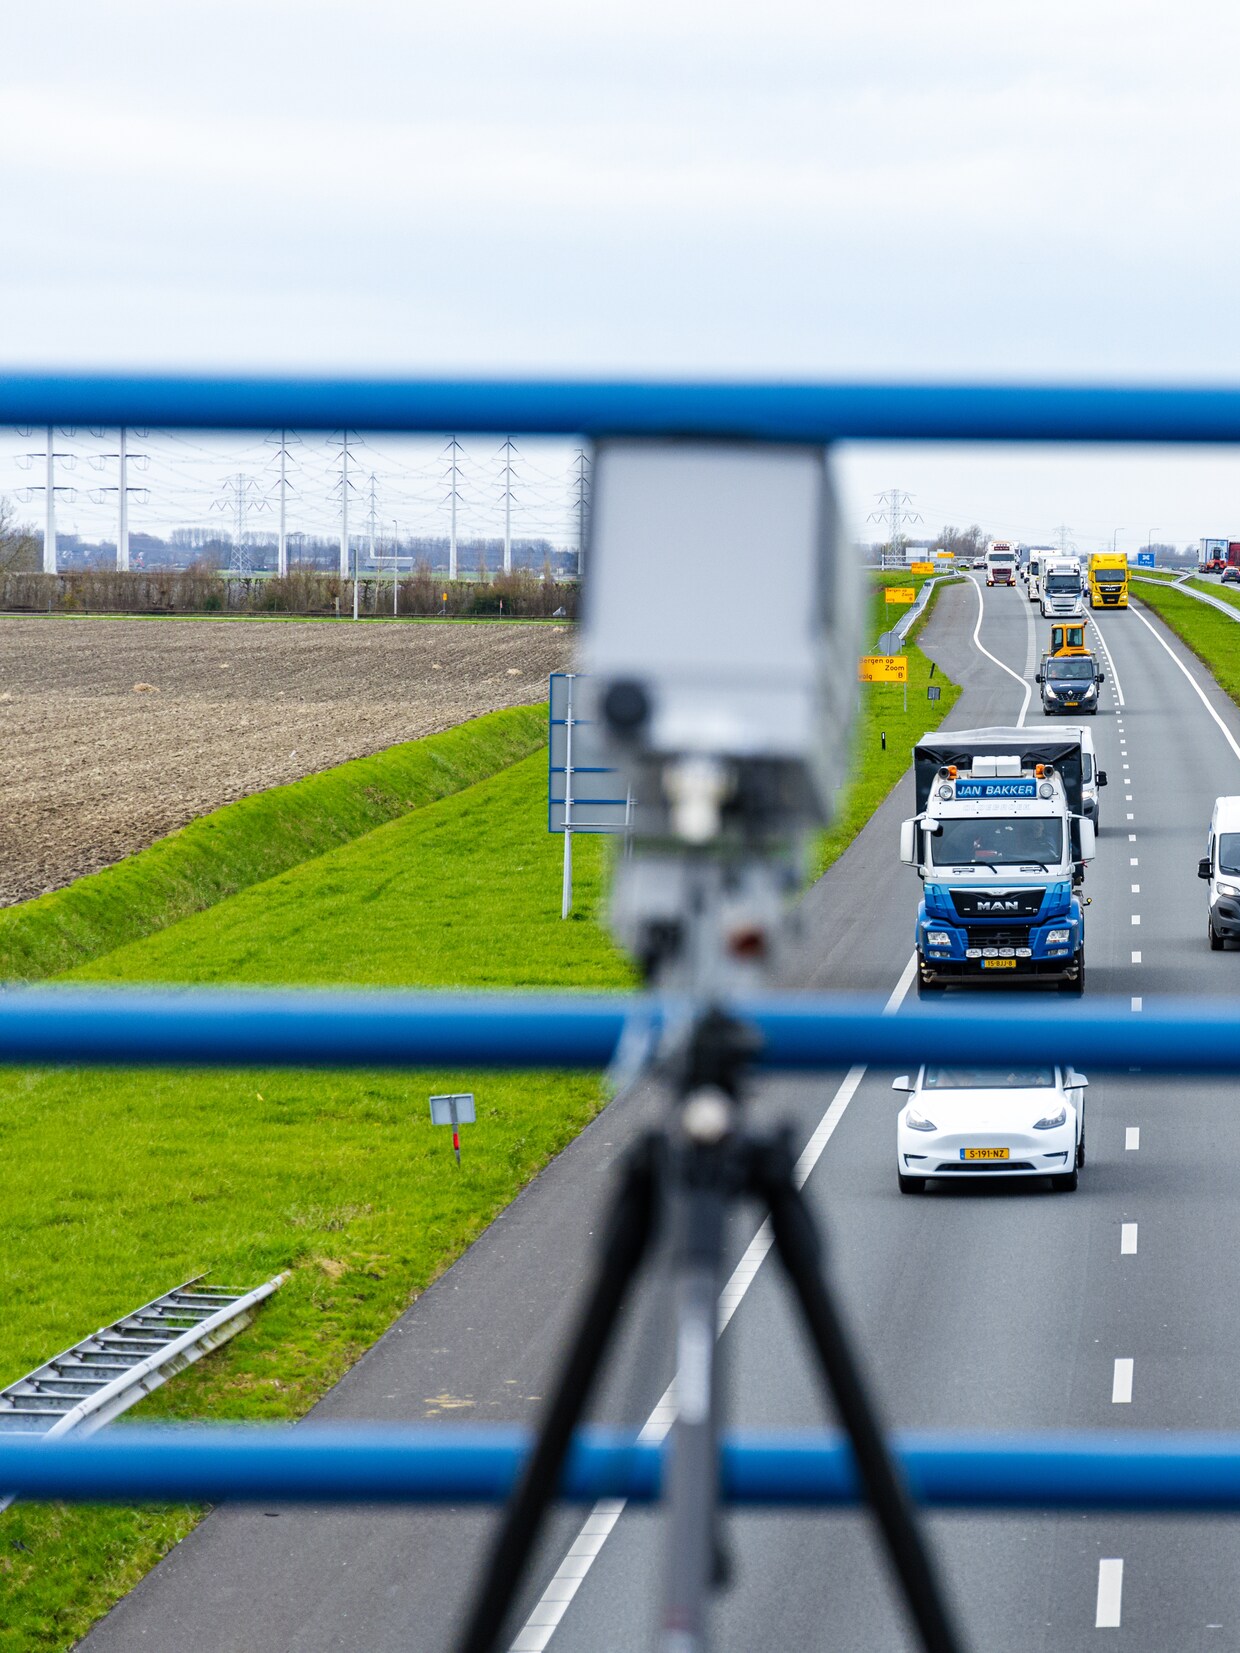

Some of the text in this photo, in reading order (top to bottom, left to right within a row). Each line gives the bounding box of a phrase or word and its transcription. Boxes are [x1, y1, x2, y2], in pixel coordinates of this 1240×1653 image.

[957, 785, 1033, 795] JAN BAKKER
[977, 901, 1018, 910] MAN
[969, 1150, 1004, 1158] S-191-NZ
